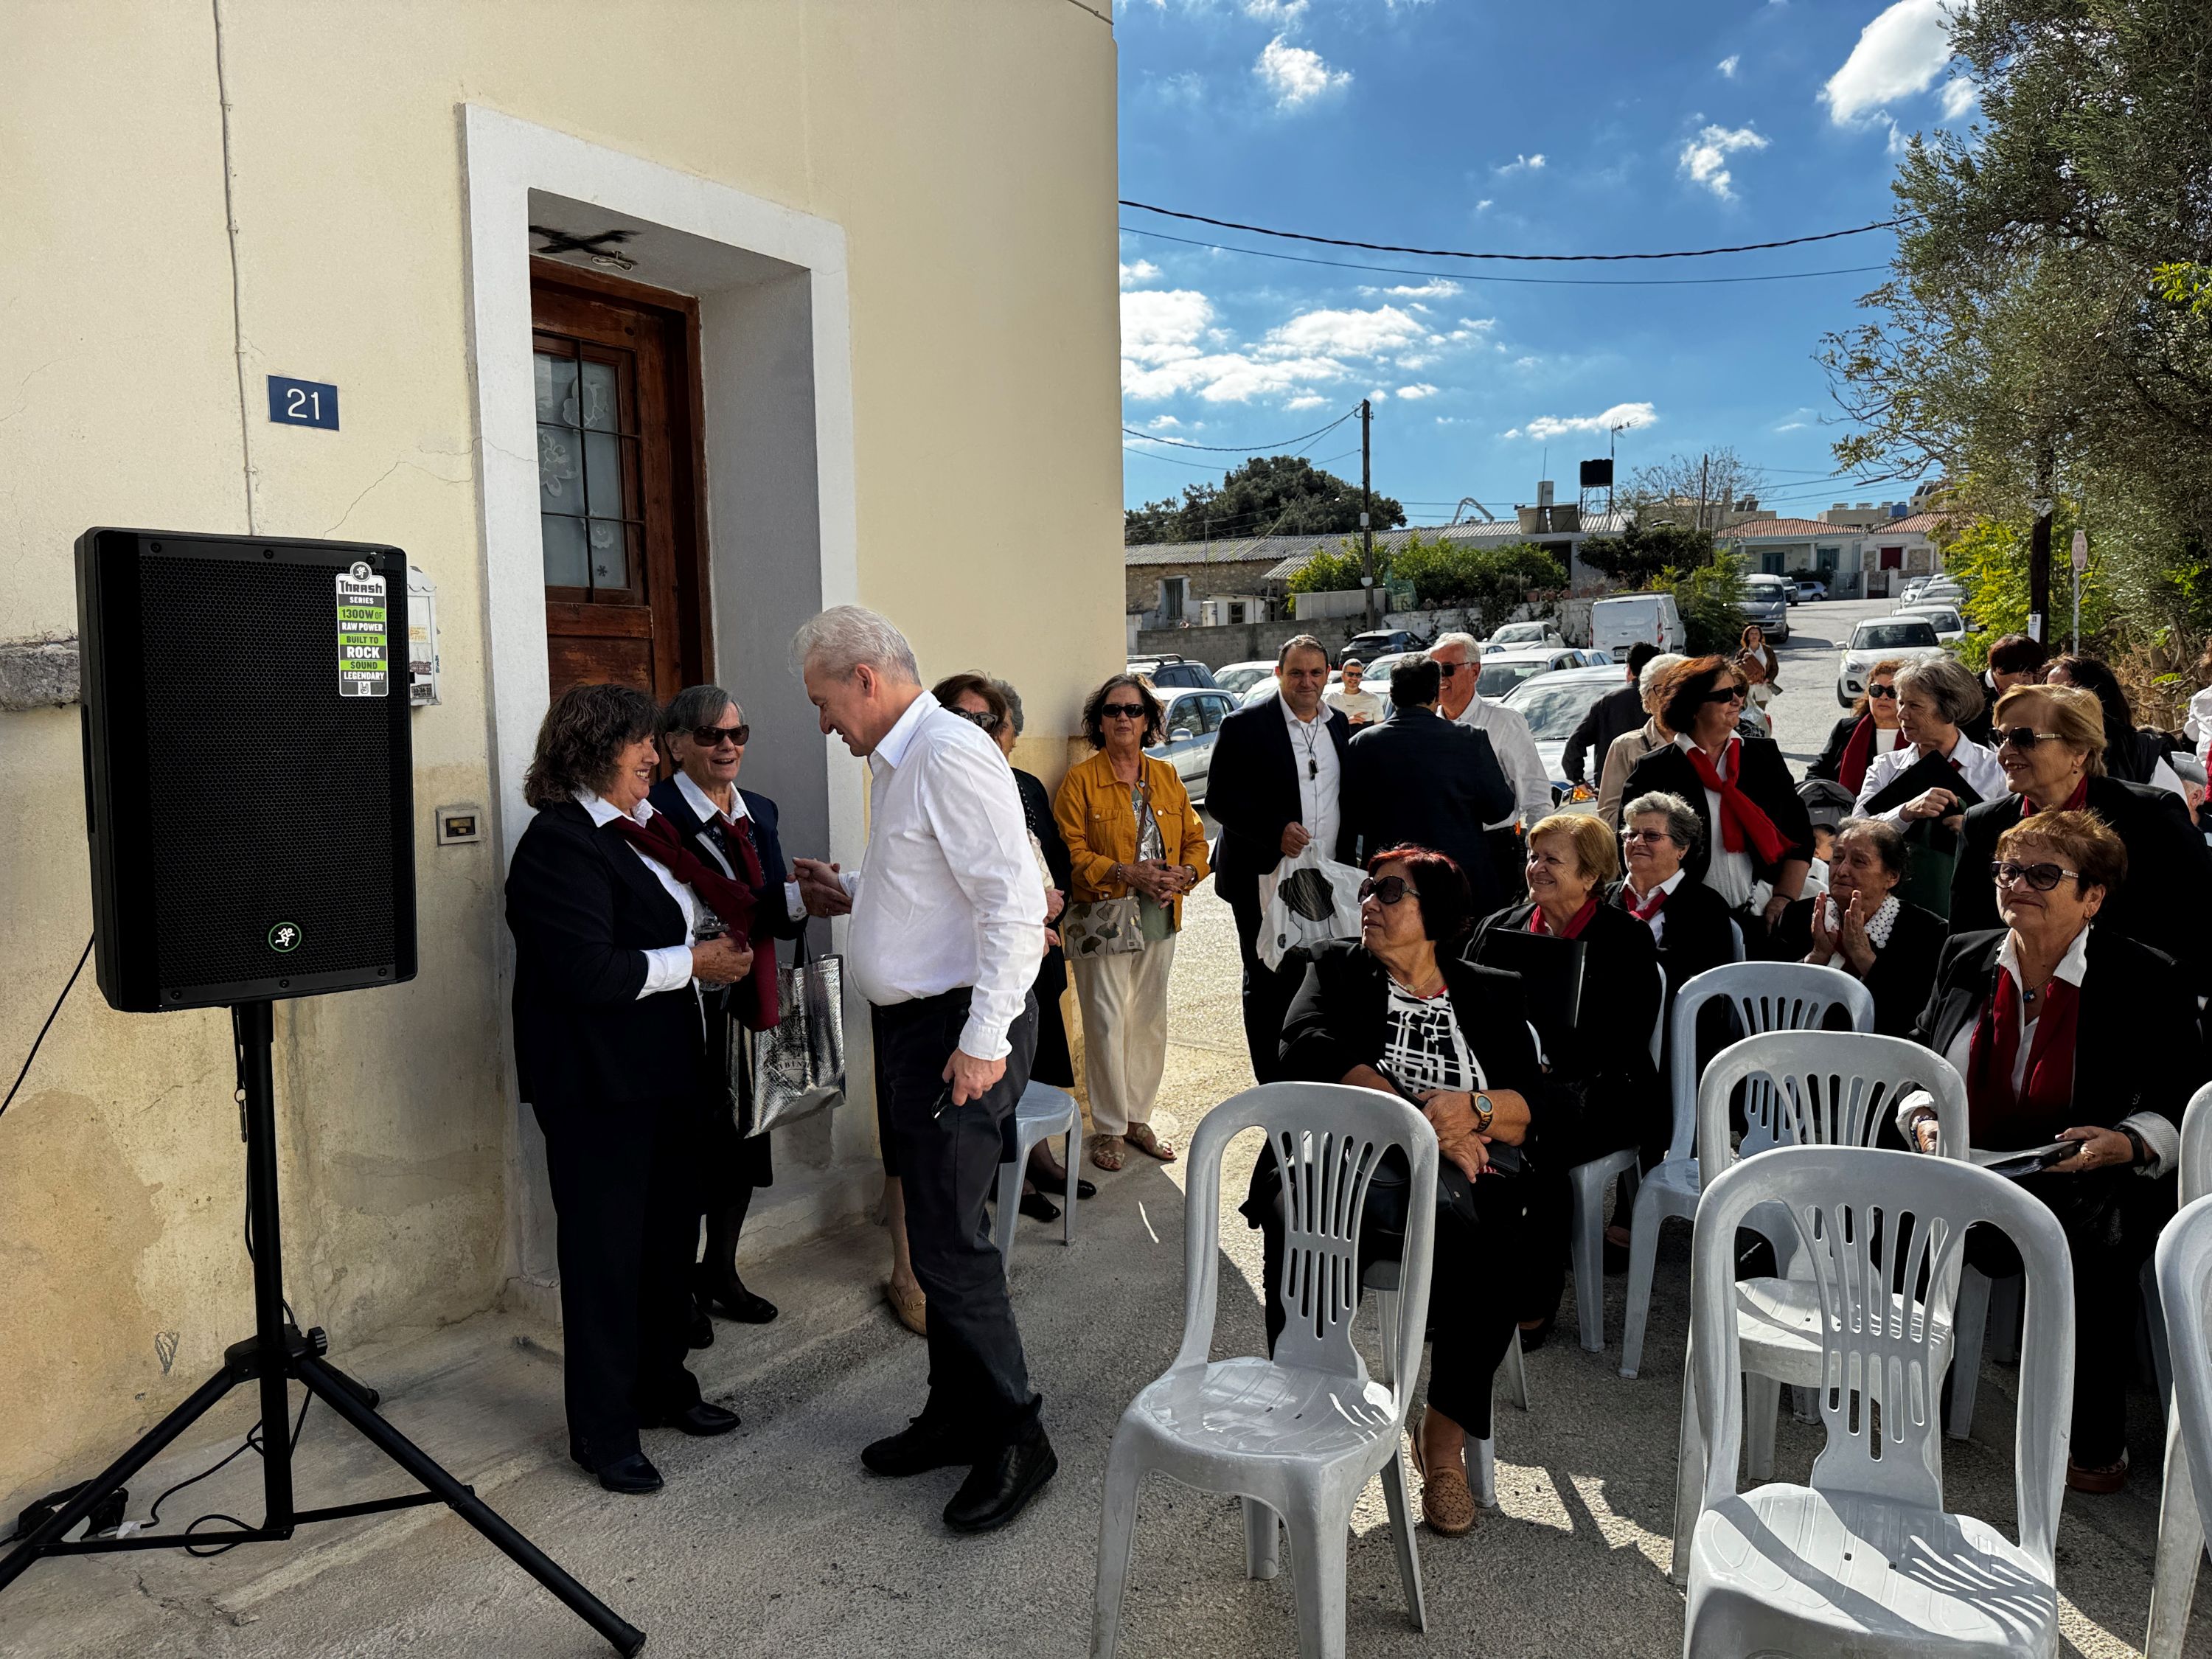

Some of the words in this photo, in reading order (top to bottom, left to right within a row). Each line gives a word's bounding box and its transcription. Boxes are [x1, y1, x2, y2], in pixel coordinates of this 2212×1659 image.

[287, 388, 320, 420] 21
[349, 597, 374, 605] SERIES
[341, 608, 375, 619] 1300W
[375, 611, 383, 620] OF
[341, 622, 358, 631] RAW
[358, 622, 383, 632] POWER
[346, 635, 367, 644] BUILT
[369, 636, 379, 644] TO
[347, 646, 380, 659] ROCK
[350, 661, 378, 669] SOUND
[344, 671, 385, 681] LEGENDARY
